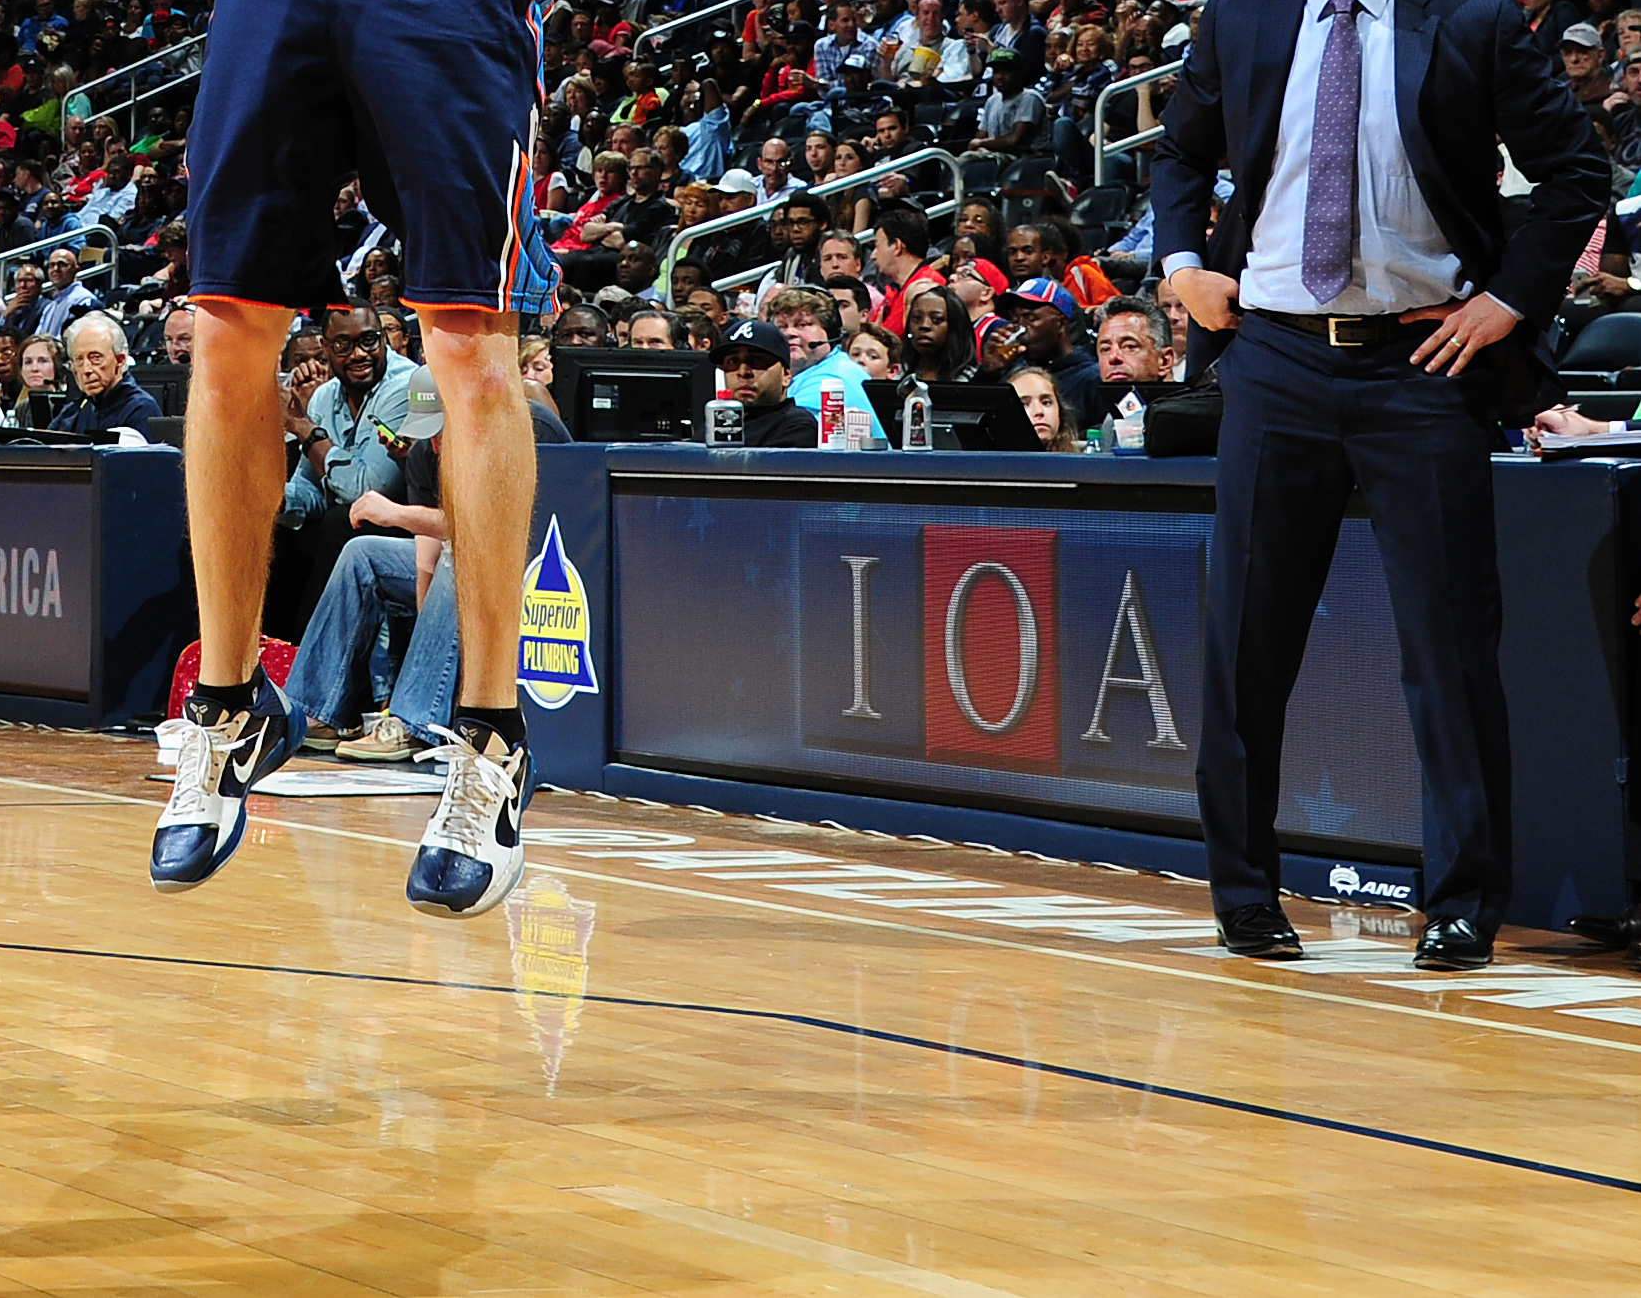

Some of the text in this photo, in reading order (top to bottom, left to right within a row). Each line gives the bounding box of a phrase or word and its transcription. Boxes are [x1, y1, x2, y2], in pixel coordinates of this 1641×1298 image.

[521, 595, 581, 634] Superior
[523, 641, 580, 675] PLUMBING
[1359, 881, 1412, 899] ANC
